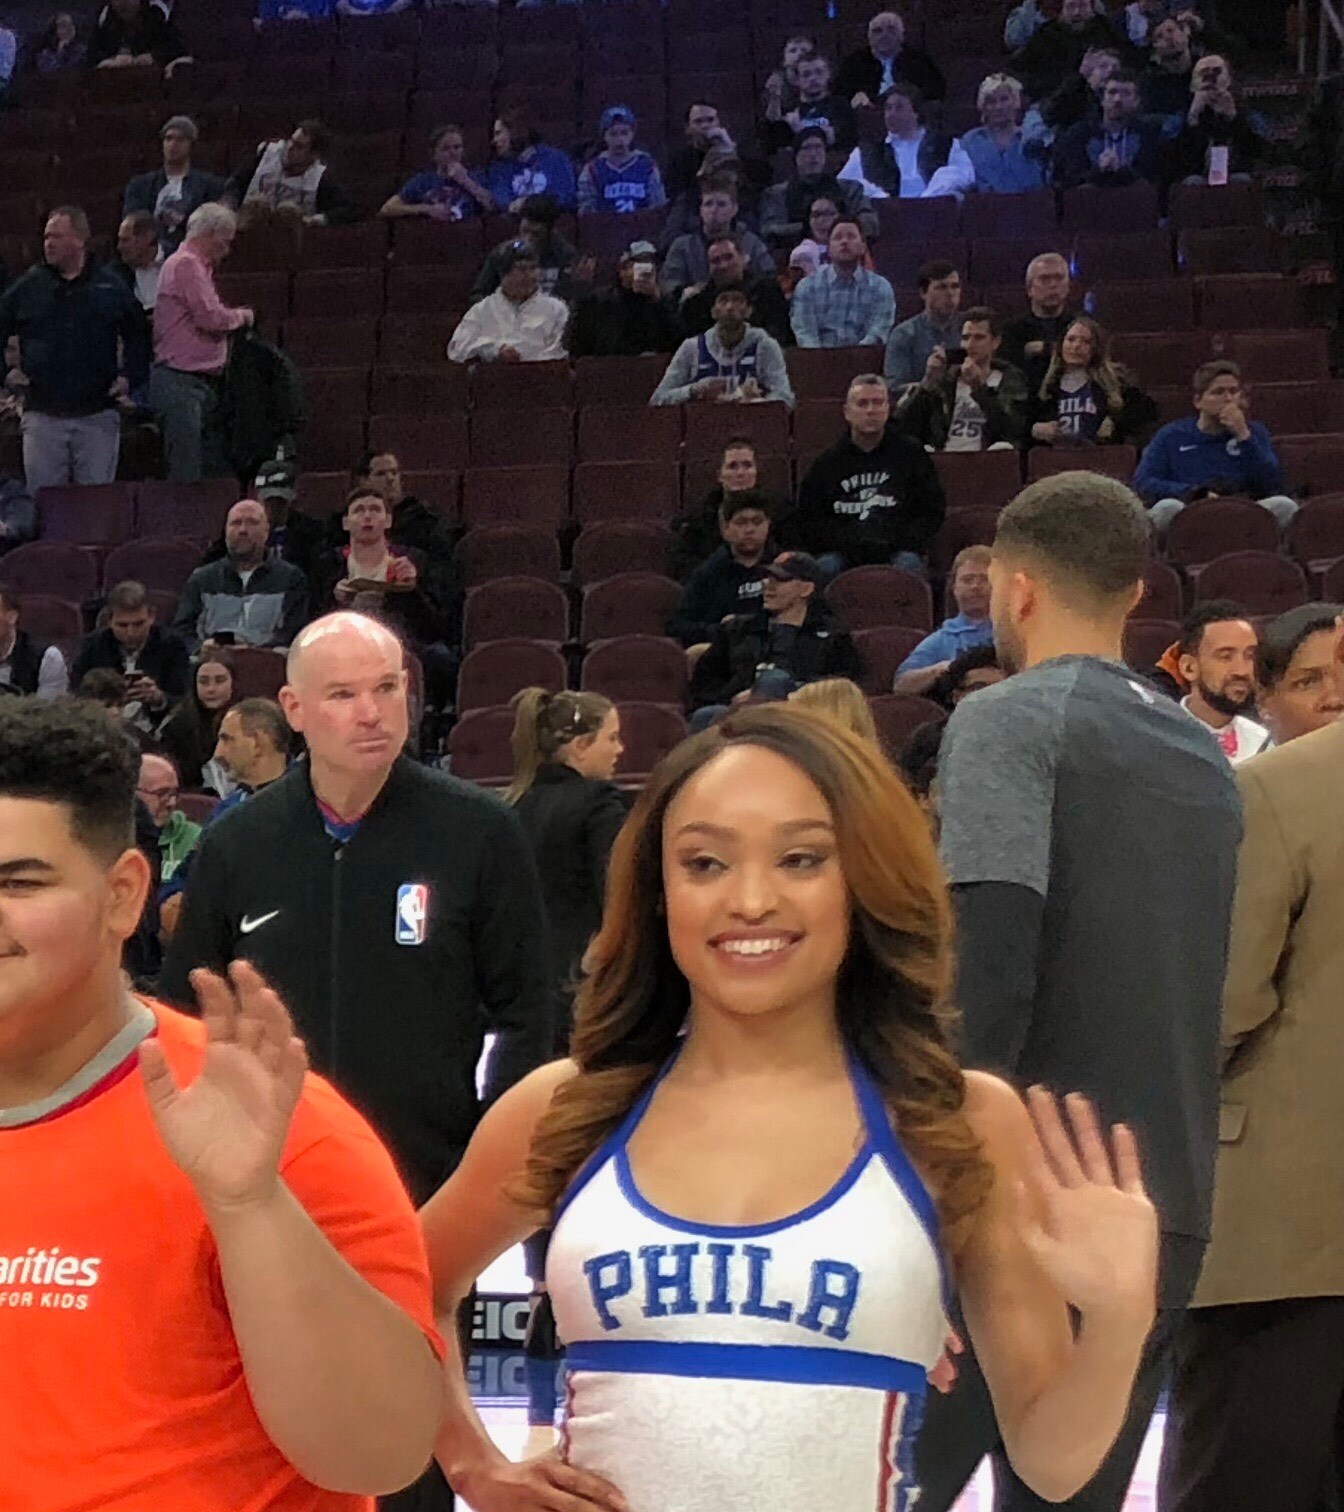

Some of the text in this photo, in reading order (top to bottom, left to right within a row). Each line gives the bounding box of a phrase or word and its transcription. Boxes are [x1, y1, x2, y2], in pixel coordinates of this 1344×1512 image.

[1058, 397, 1097, 414] HILA
[950, 420, 981, 438] 25
[583, 1241, 861, 1341] PHILA
[40, 1293, 89, 1310] KIDS
[471, 1300, 531, 1340] EIC
